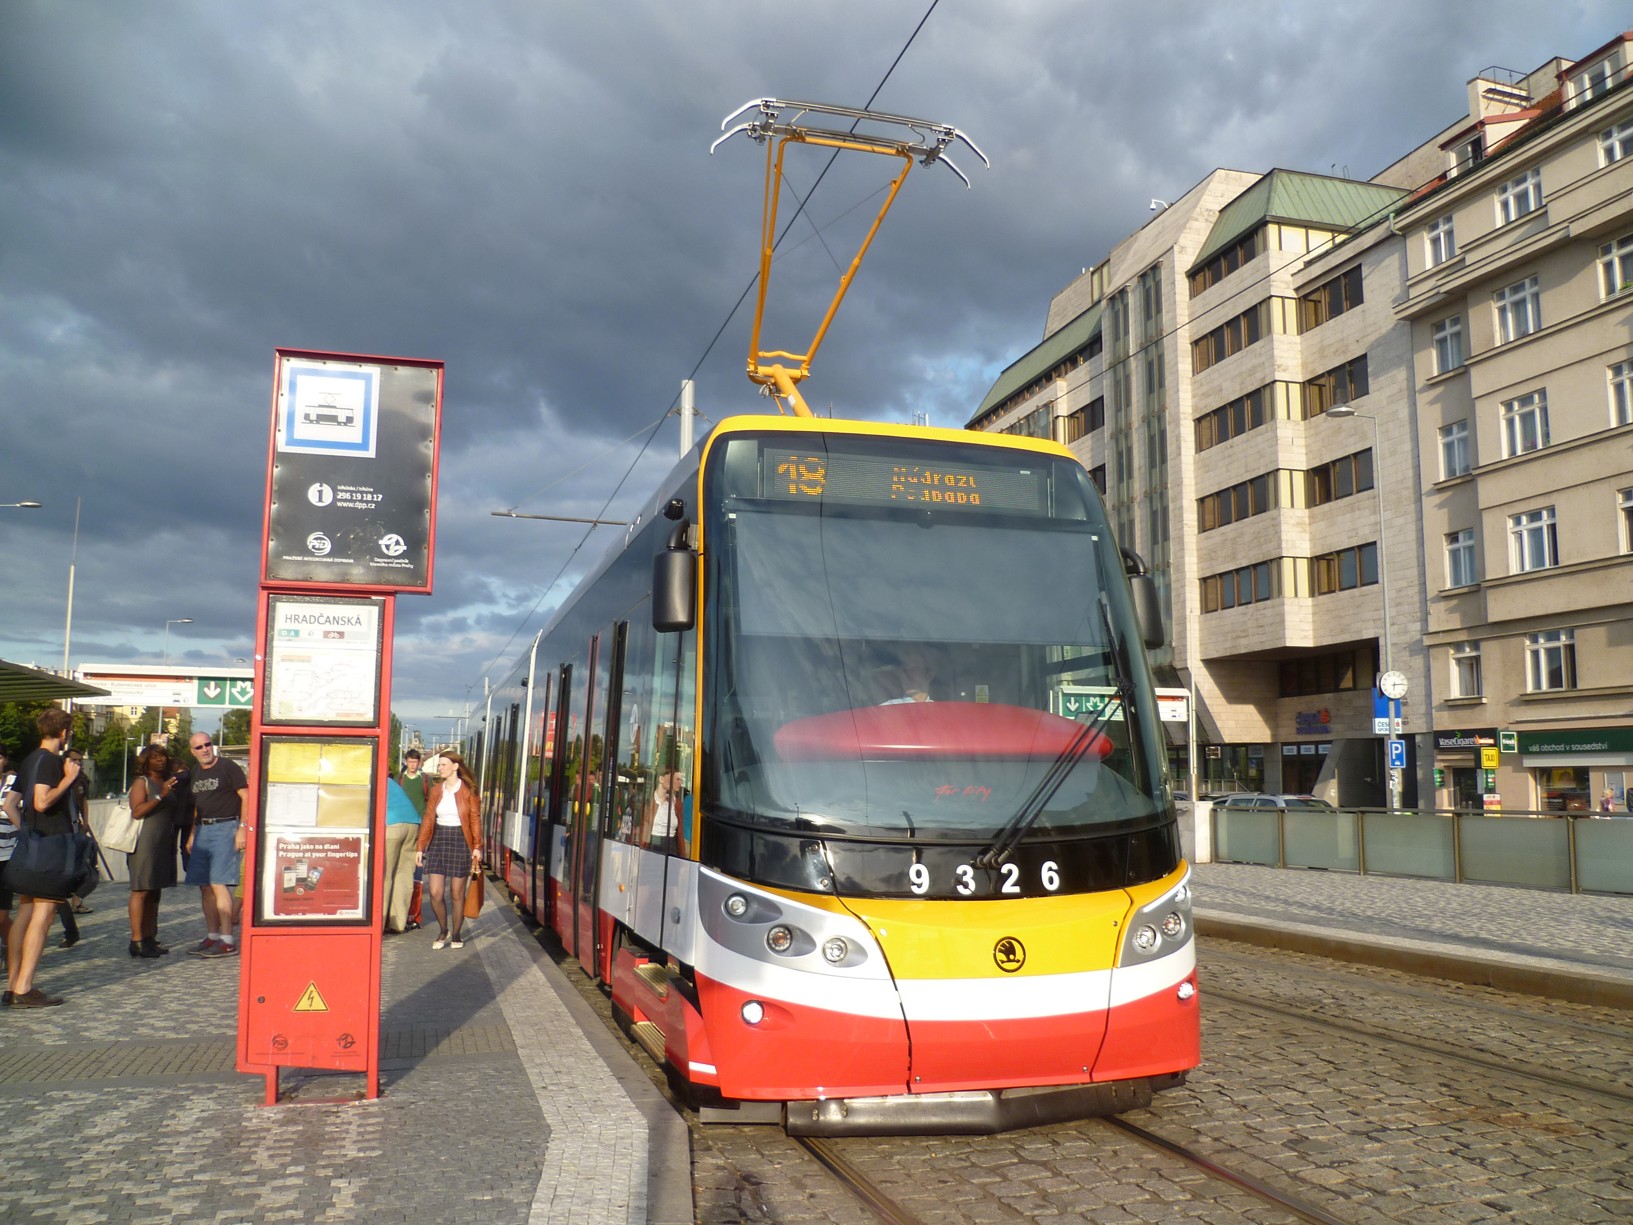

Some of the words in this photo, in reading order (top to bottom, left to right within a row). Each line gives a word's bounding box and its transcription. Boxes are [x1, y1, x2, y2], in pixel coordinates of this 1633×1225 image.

[363, 493, 372, 501] 18
[373, 494, 383, 502] 17
[336, 501, 376, 509] www.dpp.cz
[284, 612, 362, 627] HRADČANSKÁ
[1391, 743, 1402, 760] P
[1528, 744, 1540, 752] váš
[1540, 743, 1565, 752] obchod
[1571, 741, 1608, 751] sousedství
[327, 851, 358, 859] fingertips
